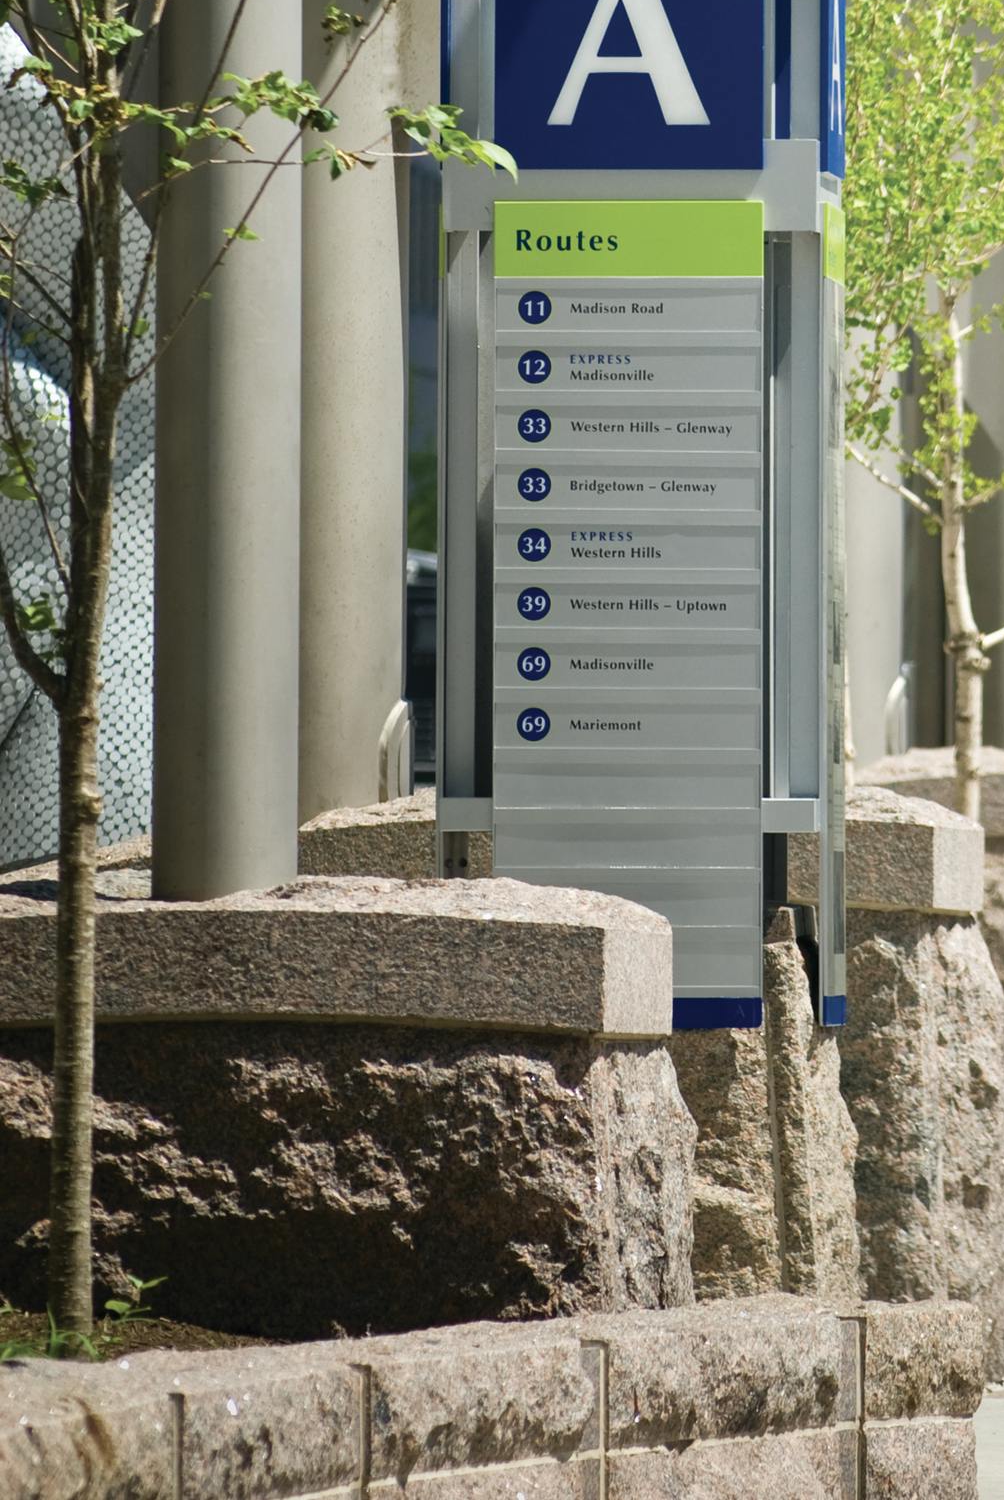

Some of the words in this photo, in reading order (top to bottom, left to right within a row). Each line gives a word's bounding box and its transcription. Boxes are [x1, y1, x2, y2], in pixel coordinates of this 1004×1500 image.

[516, 229, 618, 252] Routes
[524, 300, 545, 317] 11
[570, 302, 626, 314] Madison
[631, 302, 664, 314] Road
[523, 359, 546, 376] 12
[569, 354, 631, 365] EXPRESS
[570, 369, 654, 381] Madisonville
[523, 417, 547, 434] 33
[570, 421, 625, 433] Western
[629, 421, 660, 433] Hills
[676, 421, 733, 437] Glenway
[523, 476, 546, 494] 33
[570, 479, 644, 494] Bridgetown
[660, 480, 717, 495] Glenway
[571, 531, 633, 541] EXPRESS
[522, 536, 547, 554] 34
[570, 547, 625, 558] Western
[630, 546, 662, 558] Hills
[522, 595, 547, 612] 39
[570, 599, 624, 610] Western
[629, 598, 659, 610] Hills
[676, 599, 727, 615] Uptown
[522, 655, 546, 673] 69
[570, 658, 654, 670] Madisonville
[521, 716, 546, 733] 69
[570, 719, 641, 731] Mariemont
